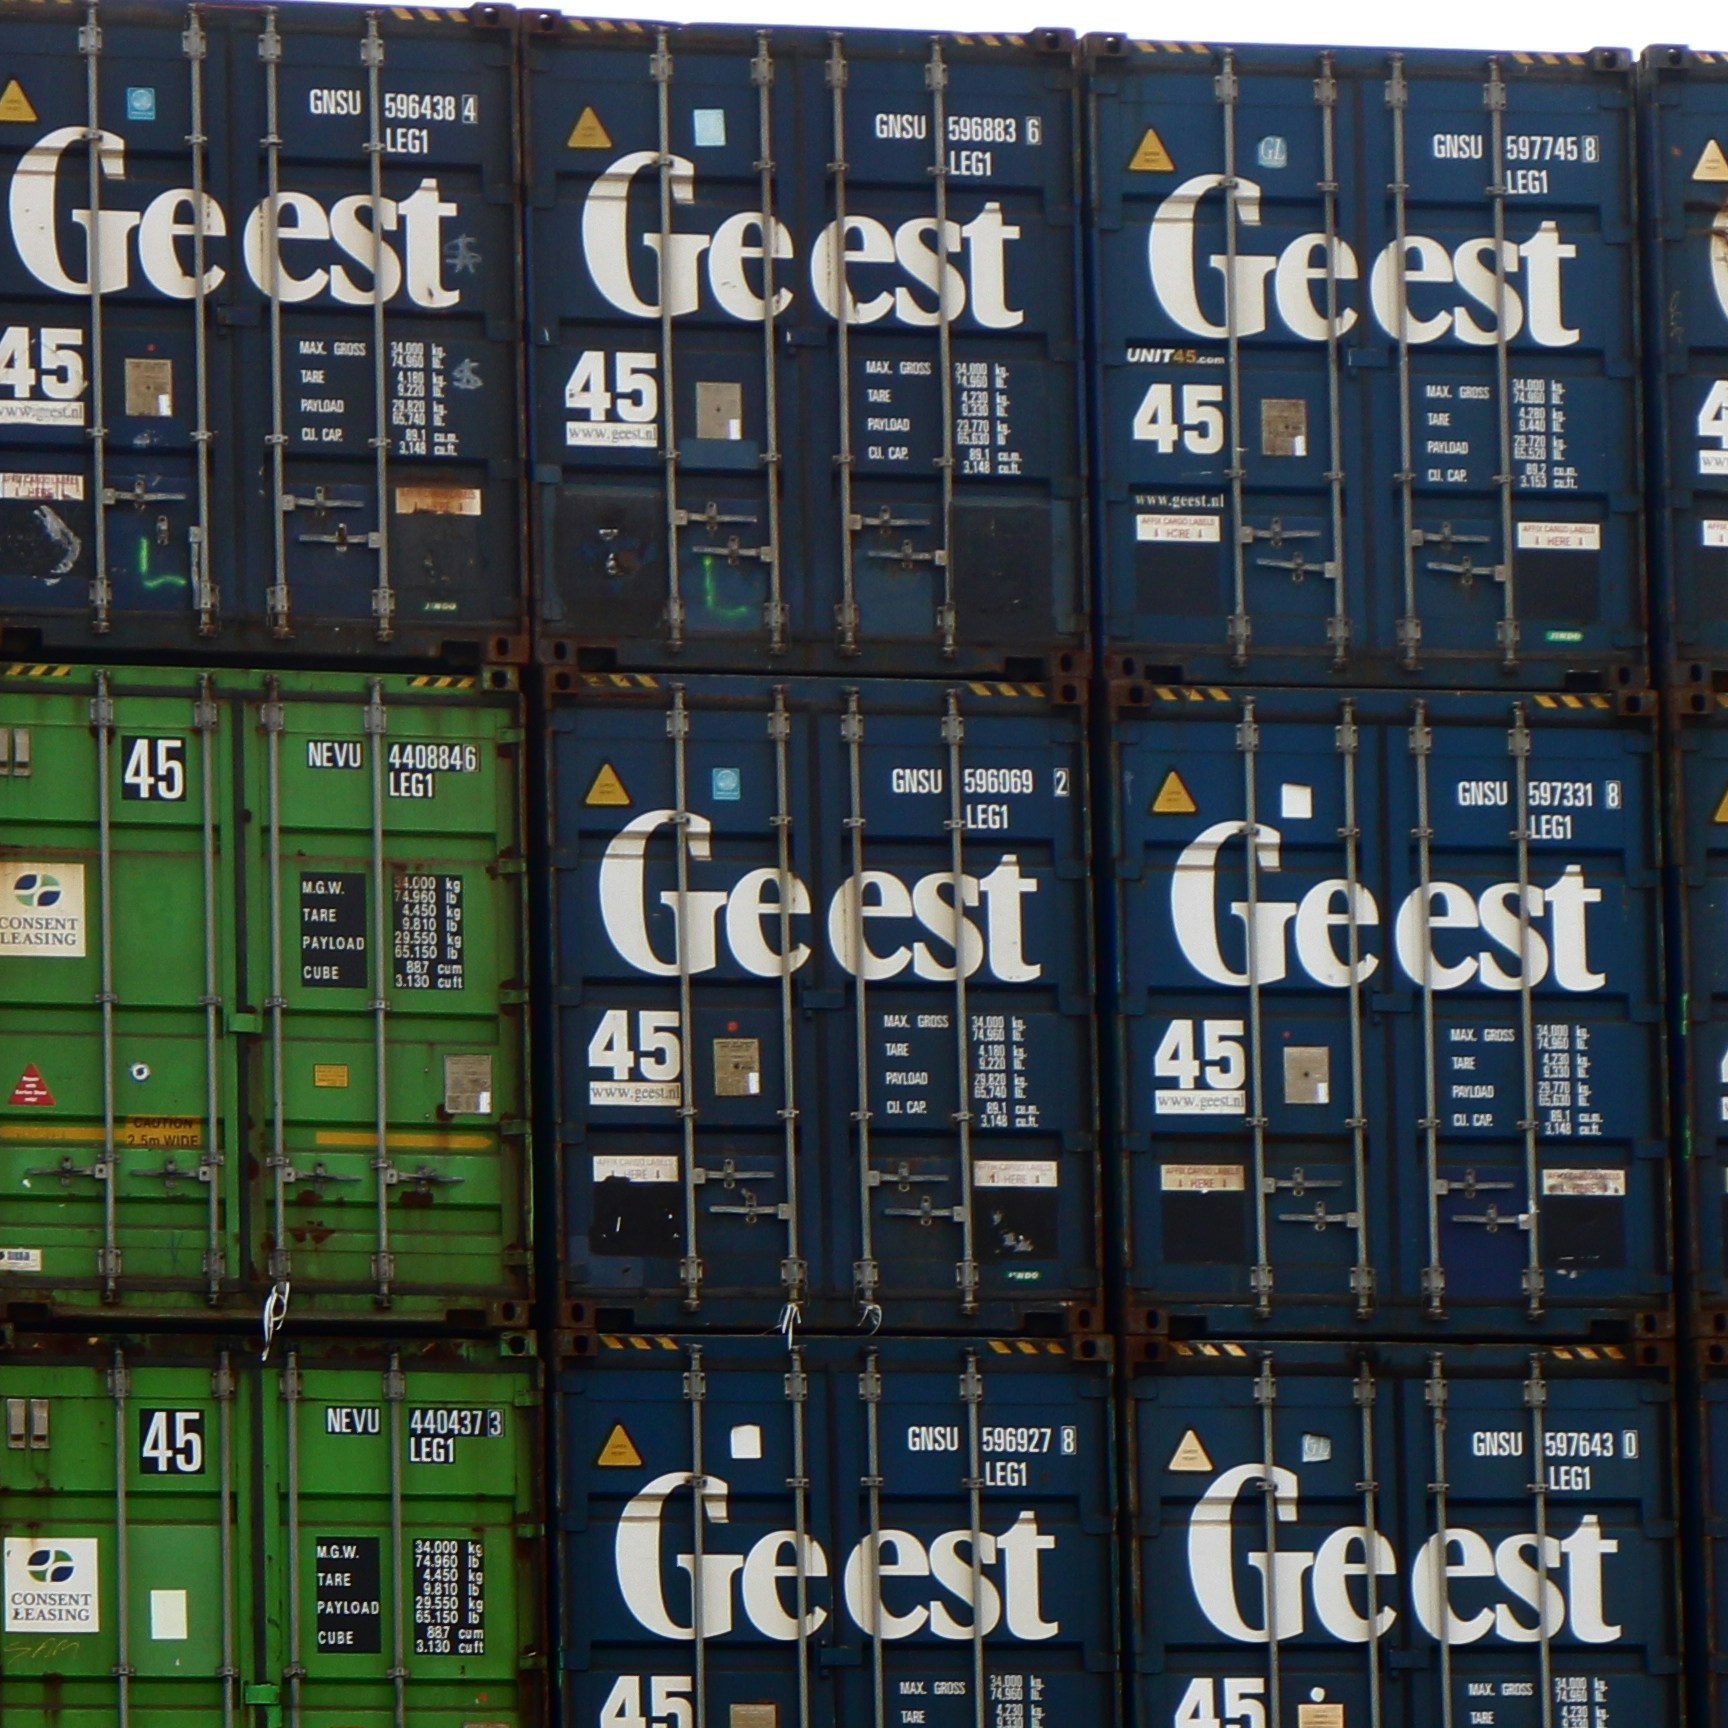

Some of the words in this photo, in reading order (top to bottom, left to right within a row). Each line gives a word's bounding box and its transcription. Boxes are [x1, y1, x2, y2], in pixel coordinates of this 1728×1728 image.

[310, 89, 360, 114] GNSU
[385, 94, 455, 120] 596438
[387, 128, 427, 153] LEG1
[1434, 135, 1482, 158] GNSU
[1507, 136, 1577, 160] 597745
[1507, 170, 1547, 193] LEG1
[8, 127, 460, 307] Geest
[582, 151, 1023, 326] Geest
[1149, 173, 1580, 347] Geest
[566, 351, 656, 422] 45
[1134, 384, 1222, 453] 45
[1135, 492, 1224, 507] www.geest.nl
[125, 739, 182, 798] 45
[1459, 782, 1507, 805] GNSU
[1529, 782, 1592, 806] 597331
[1531, 815, 1571, 838] LEG1
[599, 808, 1042, 980] Geest
[1171, 820, 1605, 990] Geest
[0, 931, 77, 947] LEASING
[589, 1010, 679, 1080] 45
[1155, 1020, 1244, 1089] 45
[143, 1412, 201, 1471] 45
[328, 1408, 378, 1432] NEVU
[411, 1410, 481, 1439] 440437
[1474, 1432, 1522, 1455] GNSU
[1546, 1433, 1613, 1456] 597643
[411, 1437, 453, 1462] LEG1
[1550, 1466, 1590, 1490] LEG1
[614, 1471, 1058, 1640] Geest
[1188, 1464, 1622, 1644] Geest
[317, 1601, 379, 1616] PAYLOAD
